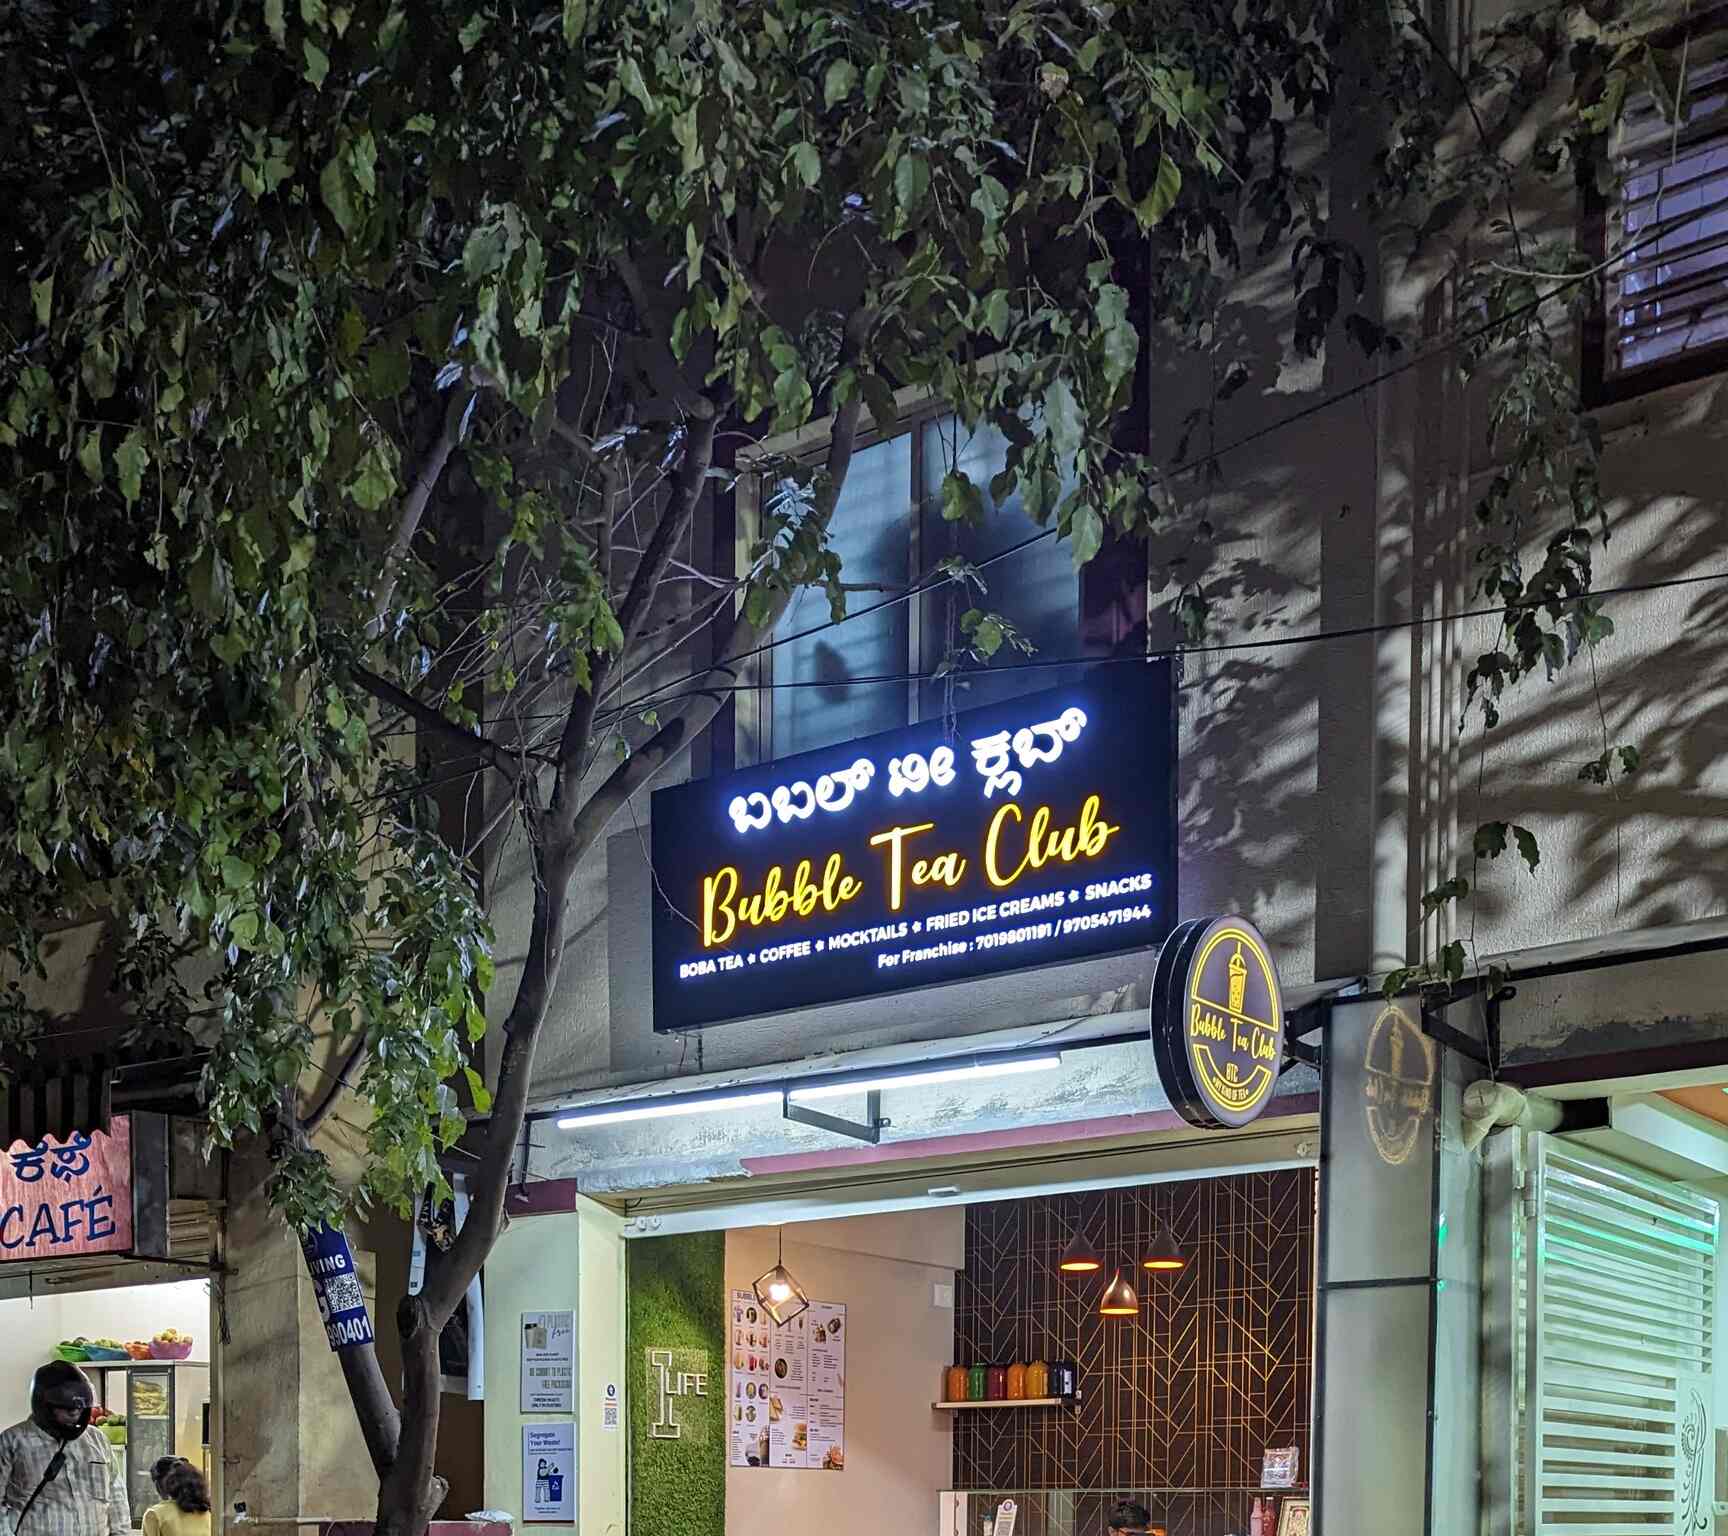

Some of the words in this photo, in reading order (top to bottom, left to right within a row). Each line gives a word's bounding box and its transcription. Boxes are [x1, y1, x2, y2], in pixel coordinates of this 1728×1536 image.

[729, 758, 875, 833] ಬಬಲ್
[888, 745, 956, 798] ಟೀ
[970, 707, 1088, 798] ಕ್ಲಬ್
[703, 852, 862, 947] Bubble
[870, 822, 967, 910] Tea
[984, 794, 1119, 888] Club
[679, 958, 717, 979] BOBA
[718, 954, 744, 972] TEA
[759, 940, 811, 963] COFFEE
[828, 922, 909, 951] MOCKTAILS
[926, 909, 969, 933] FRIED
[972, 903, 997, 923] ICE
[999, 891, 1065, 917] CREAMS
[1084, 873, 1153, 901] SNACKS
[878, 950, 900, 969] For
[902, 940, 968, 964] Franchise
[1190, 1002, 1227, 1041] Bubble
[1230, 1017, 1249, 1053] Tea
[1251, 1026, 1277, 1061] Club
[1226, 1062, 1239, 1082] BTC
[0, 1184, 116, 1249] CAFÉ
[665, 1371, 708, 1396] LIFE
